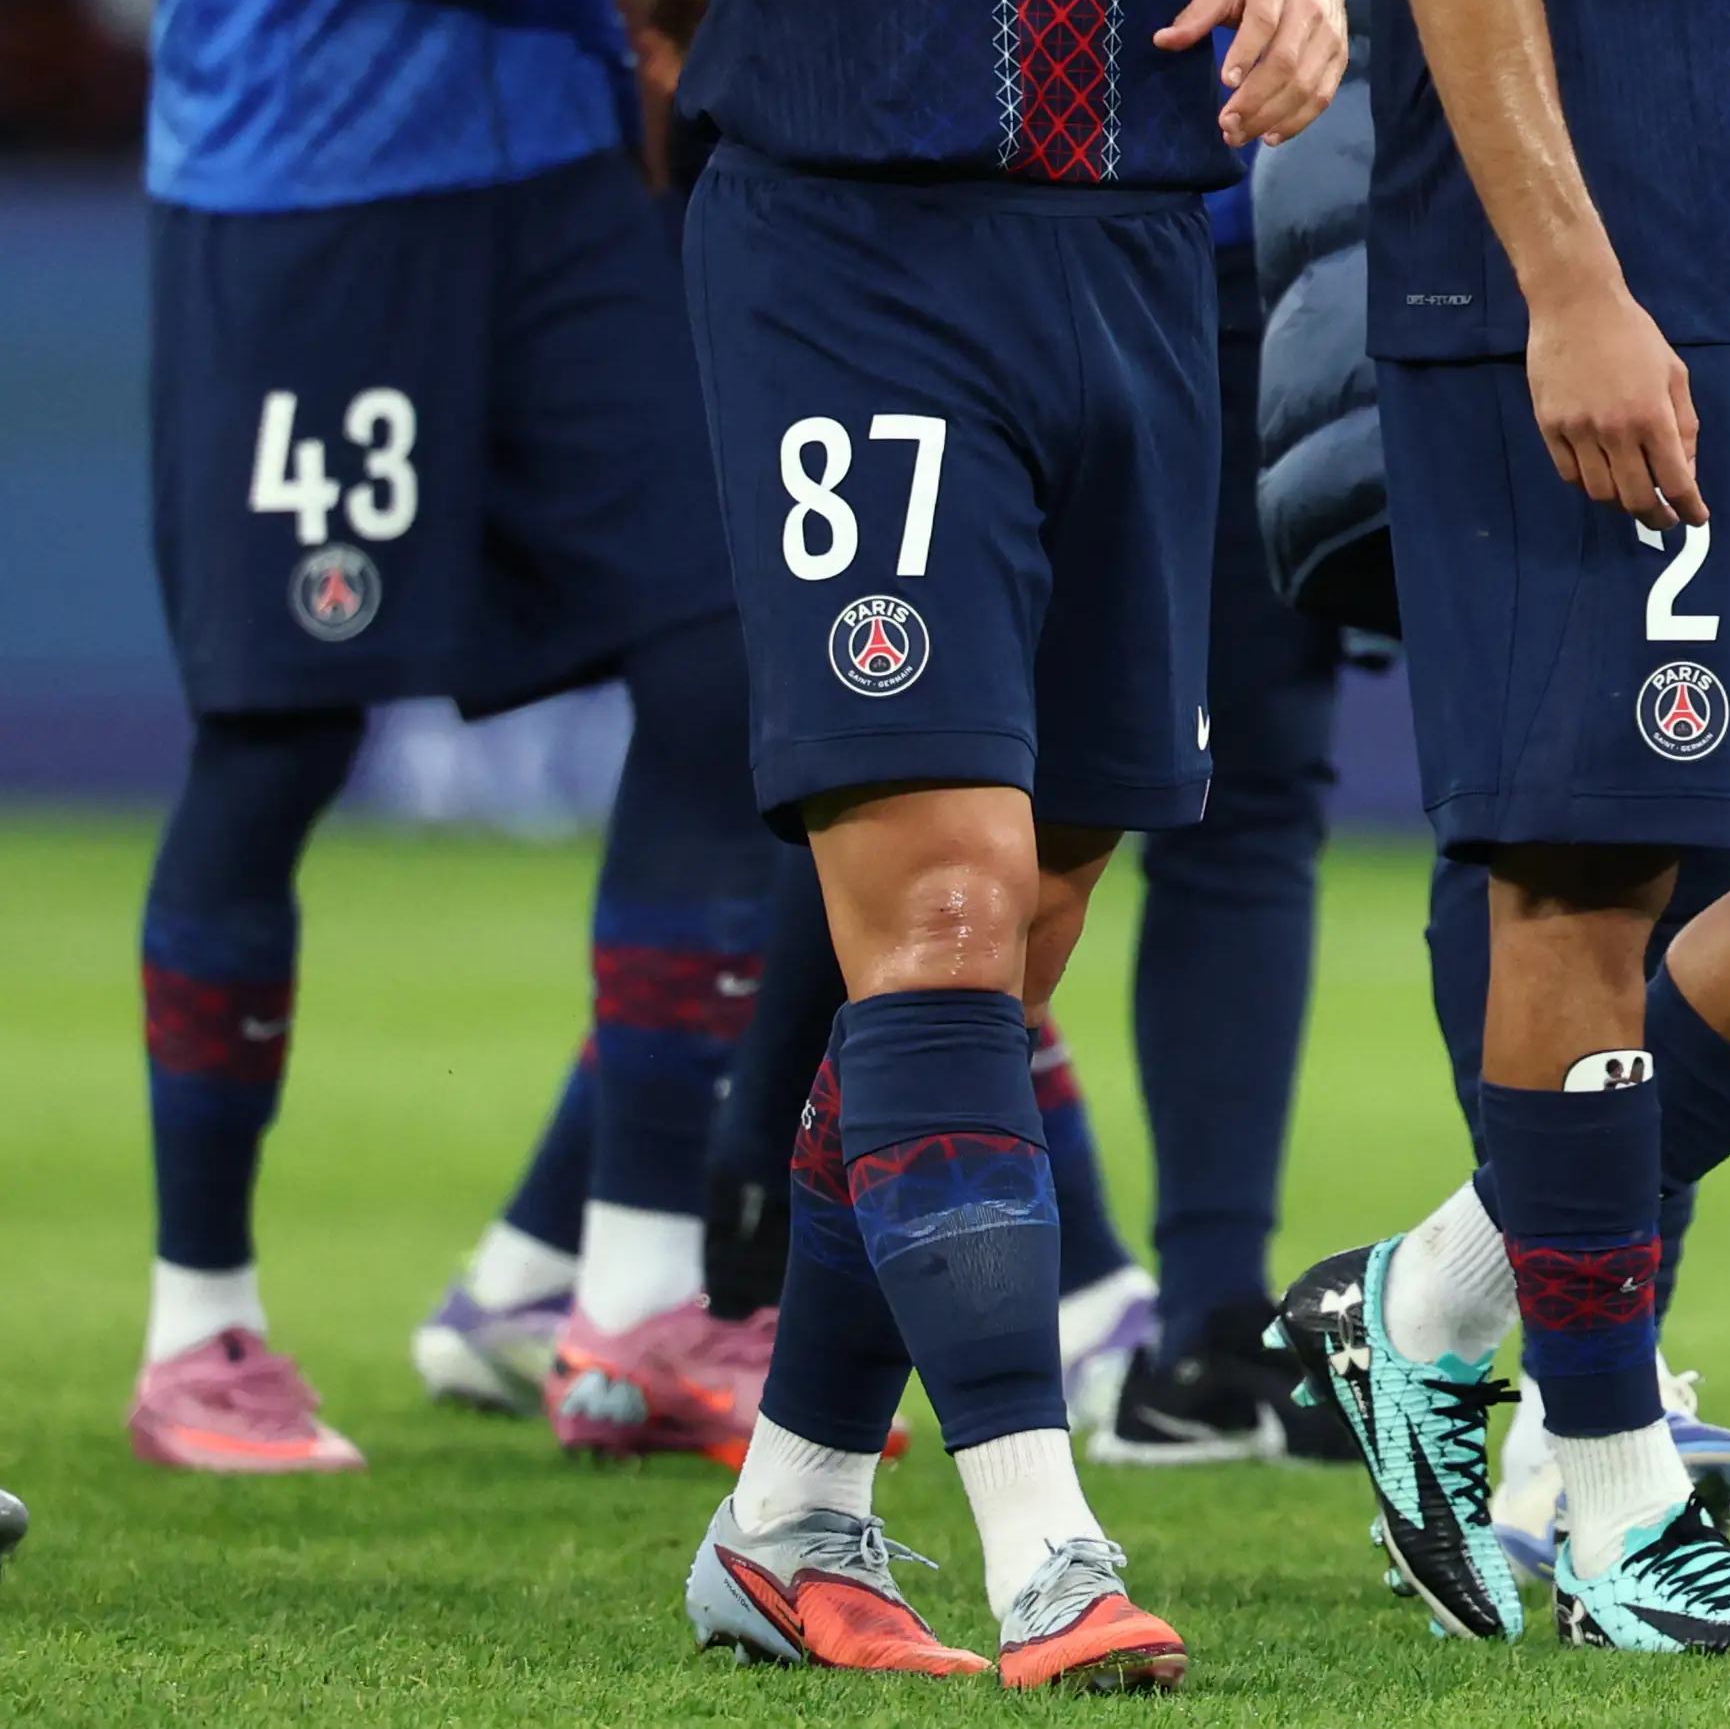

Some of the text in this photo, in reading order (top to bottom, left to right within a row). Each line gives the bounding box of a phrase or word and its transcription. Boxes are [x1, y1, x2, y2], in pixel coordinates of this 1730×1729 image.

[249, 387, 419, 545] 43
[780, 414, 947, 581] 87
[1634, 486, 1720, 641] 2
[843, 600, 910, 627] PARIS
[848, 665, 913, 688] SAINT GERMAIN
[1652, 666, 1713, 691] PARIS
